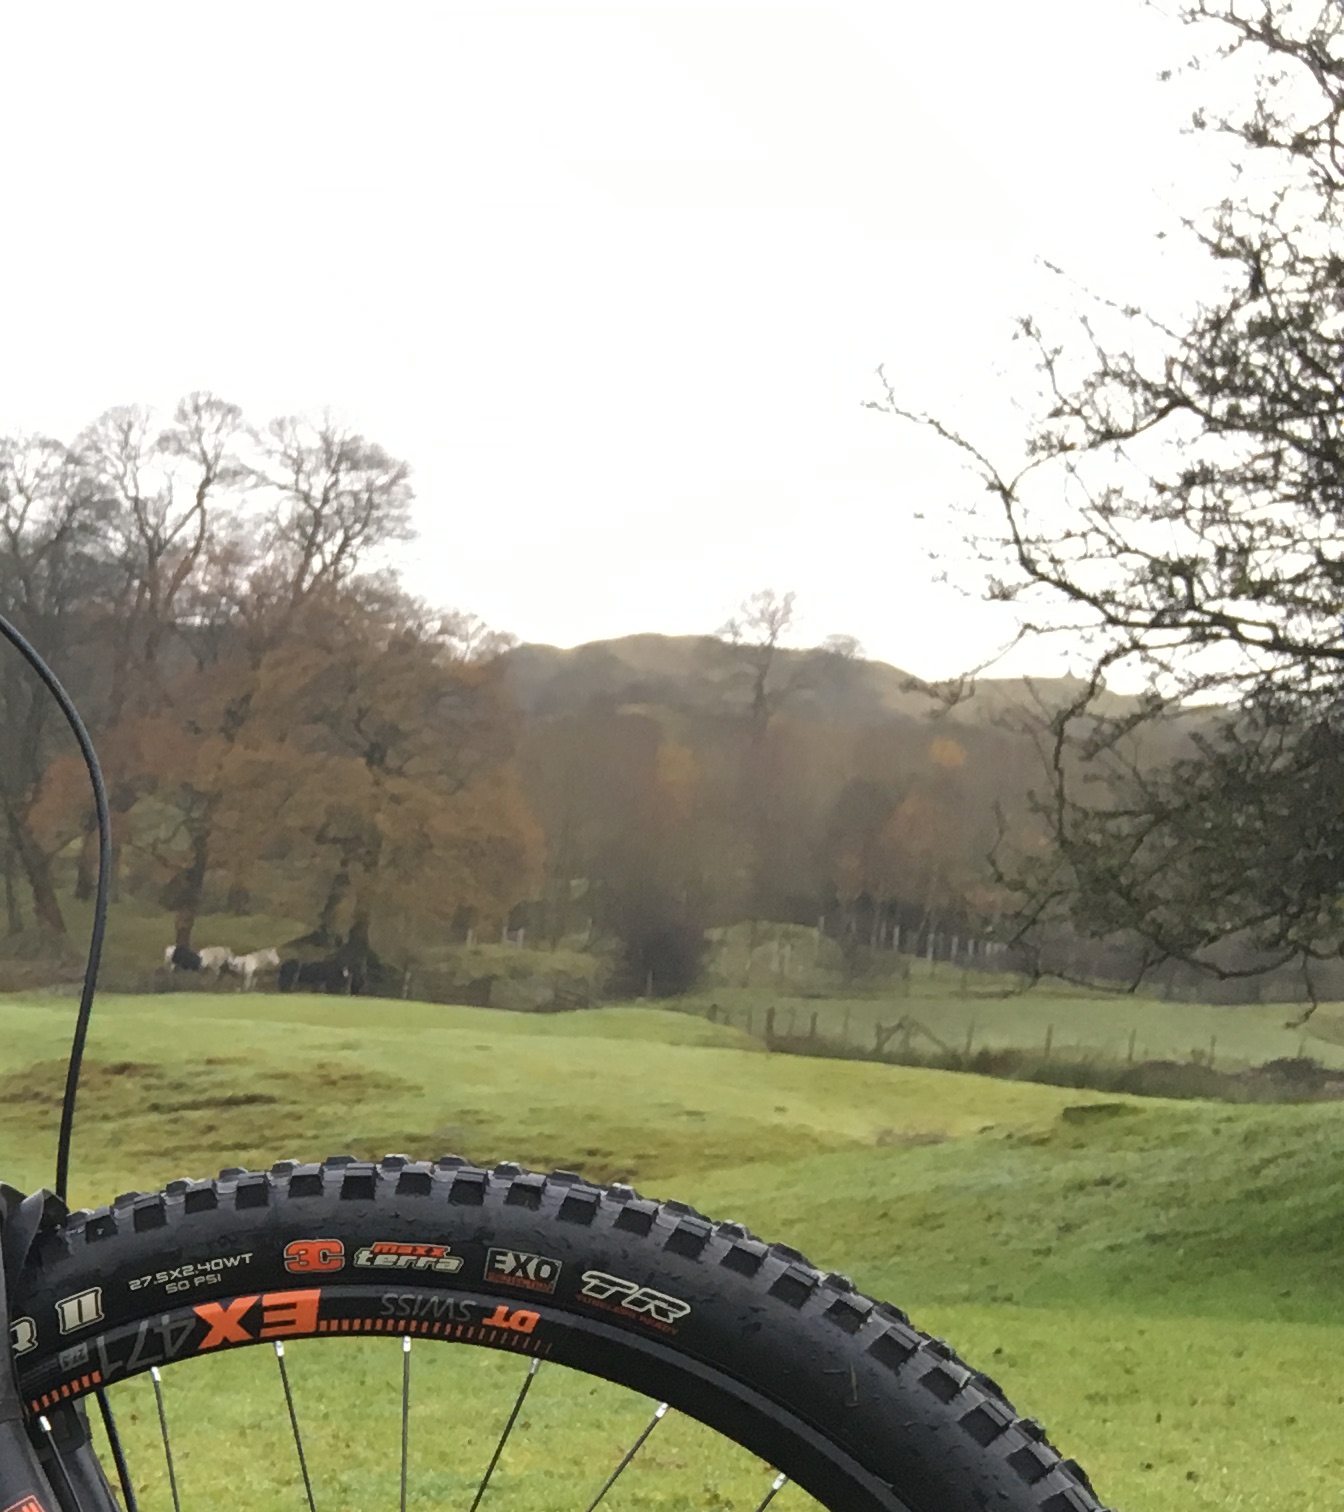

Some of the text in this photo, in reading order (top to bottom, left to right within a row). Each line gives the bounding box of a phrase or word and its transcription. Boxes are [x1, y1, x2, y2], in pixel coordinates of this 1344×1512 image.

[129, 1252, 254, 1291] 27.5X2.40WT
[283, 1239, 344, 1273] 3C
[354, 1248, 463, 1273] terra
[487, 1249, 560, 1283] EXO
[165, 1274, 222, 1294] 50 PSI
[582, 1270, 691, 1324] TR
[380, 1292, 477, 1323] SWISS
[481, 1304, 541, 1334] DT
